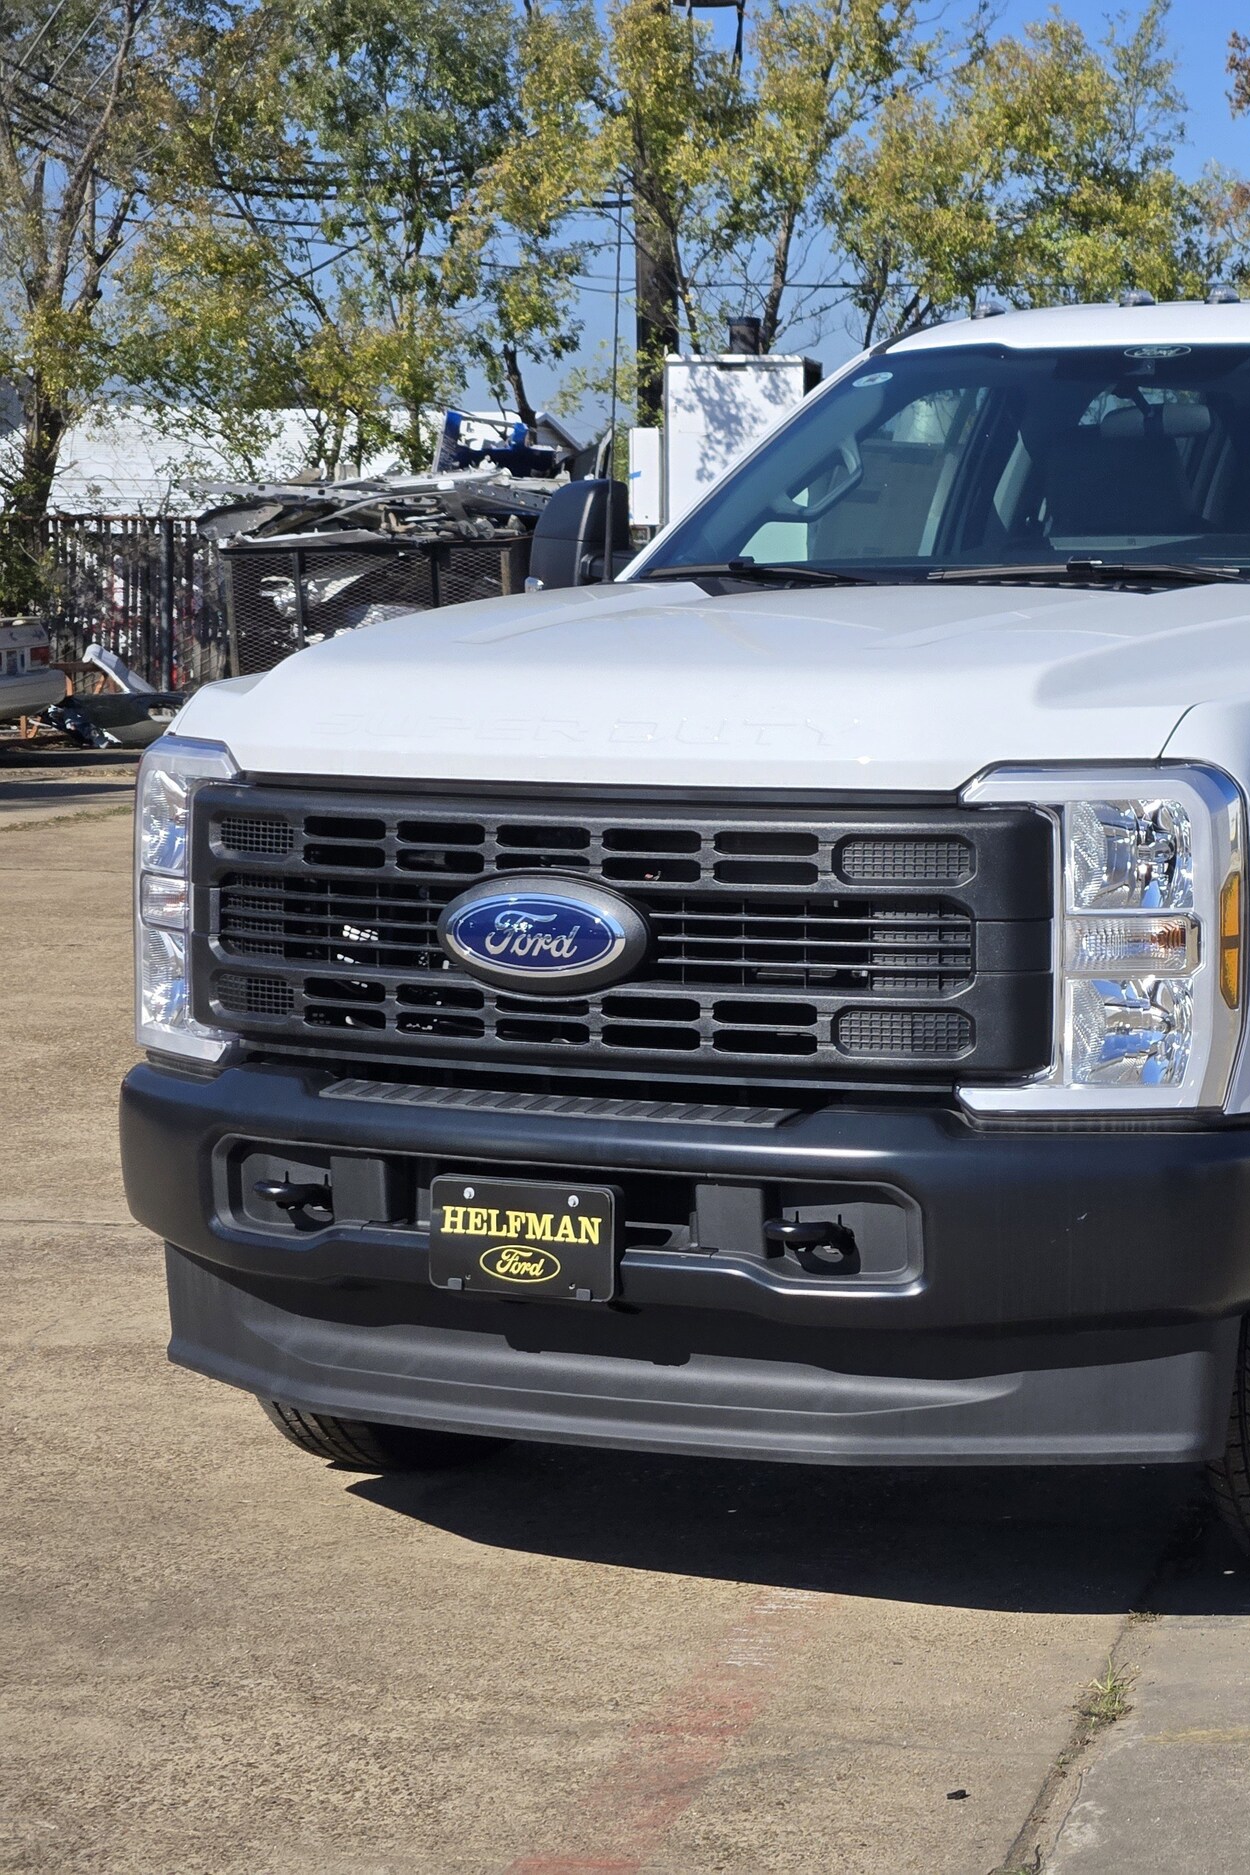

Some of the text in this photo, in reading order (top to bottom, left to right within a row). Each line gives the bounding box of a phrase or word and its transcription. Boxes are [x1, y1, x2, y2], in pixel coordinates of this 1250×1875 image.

[312, 712, 862, 747] SUPER DUTY
[485, 910, 580, 958] Ford
[440, 1205, 602, 1245] HELFMAN
[496, 1249, 545, 1276] Ford
